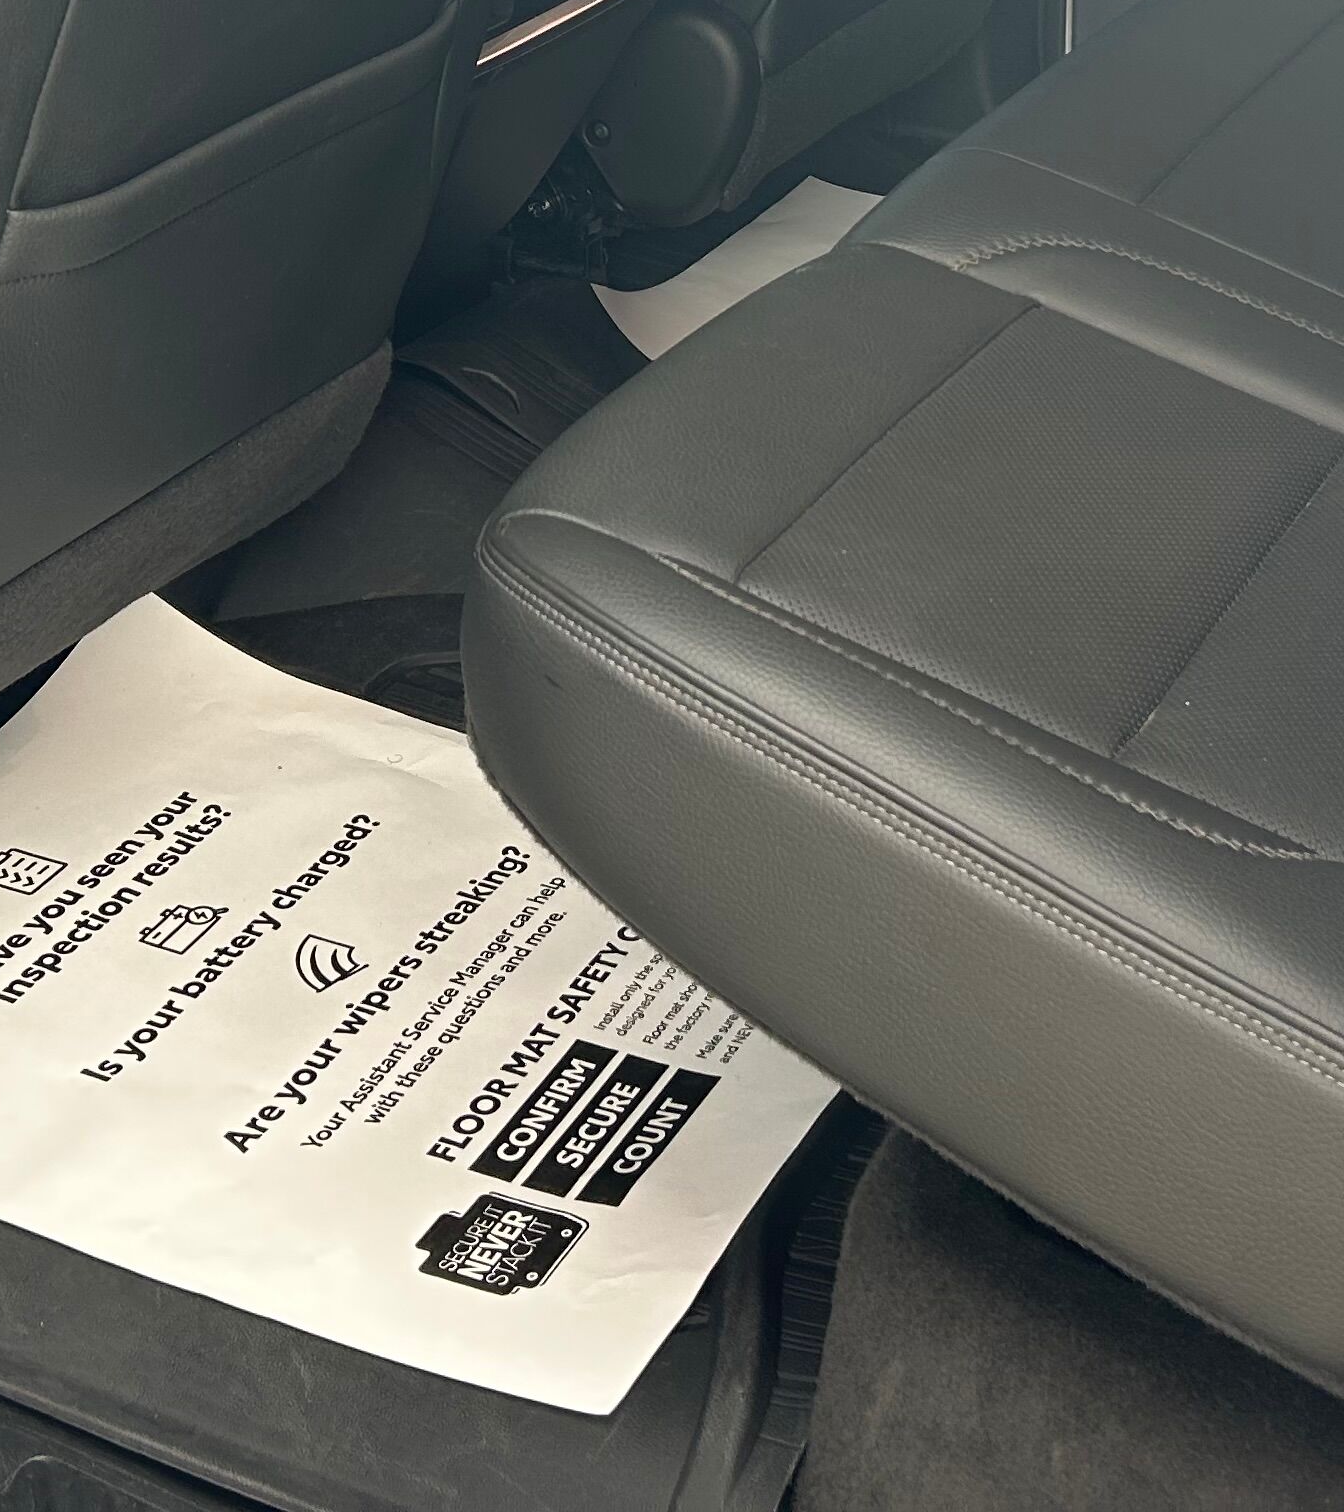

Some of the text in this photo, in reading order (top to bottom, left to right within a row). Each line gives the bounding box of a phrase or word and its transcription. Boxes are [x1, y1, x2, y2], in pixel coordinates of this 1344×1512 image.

[23, 890, 84, 935] you
[77, 839, 145, 888] seen
[134, 791, 198, 841] your
[132, 804, 232, 886] results?
[80, 814, 381, 1082] Is your battery charged?
[223, 845, 531, 1154] Are your wipers streaking?
[300, 876, 566, 1150] Your Assistant Service Manager can help
[364, 911, 568, 1126] with these questions and more.
[593, 965, 654, 1031] Install only the
[616, 992, 655, 1037] designed
[648, 978, 666, 993] for
[643, 1020, 668, 1044] Floor
[665, 1002, 685, 1021] mat
[664, 1034, 683, 1050] the
[676, 1001, 711, 1035] factory
[695, 1013, 739, 1059] Make sure
[426, 941, 629, 1162] FLOOR MAT SAFETY
[719, 1045, 739, 1064] and
[496, 1057, 596, 1162] CONFIRM
[556, 1081, 641, 1169] SECURE
[612, 1097, 688, 1174] COUNT
[439, 1204, 504, 1272] SECURE IT
[457, 1210, 534, 1281] NEVER
[485, 1217, 552, 1286] STACK IT
